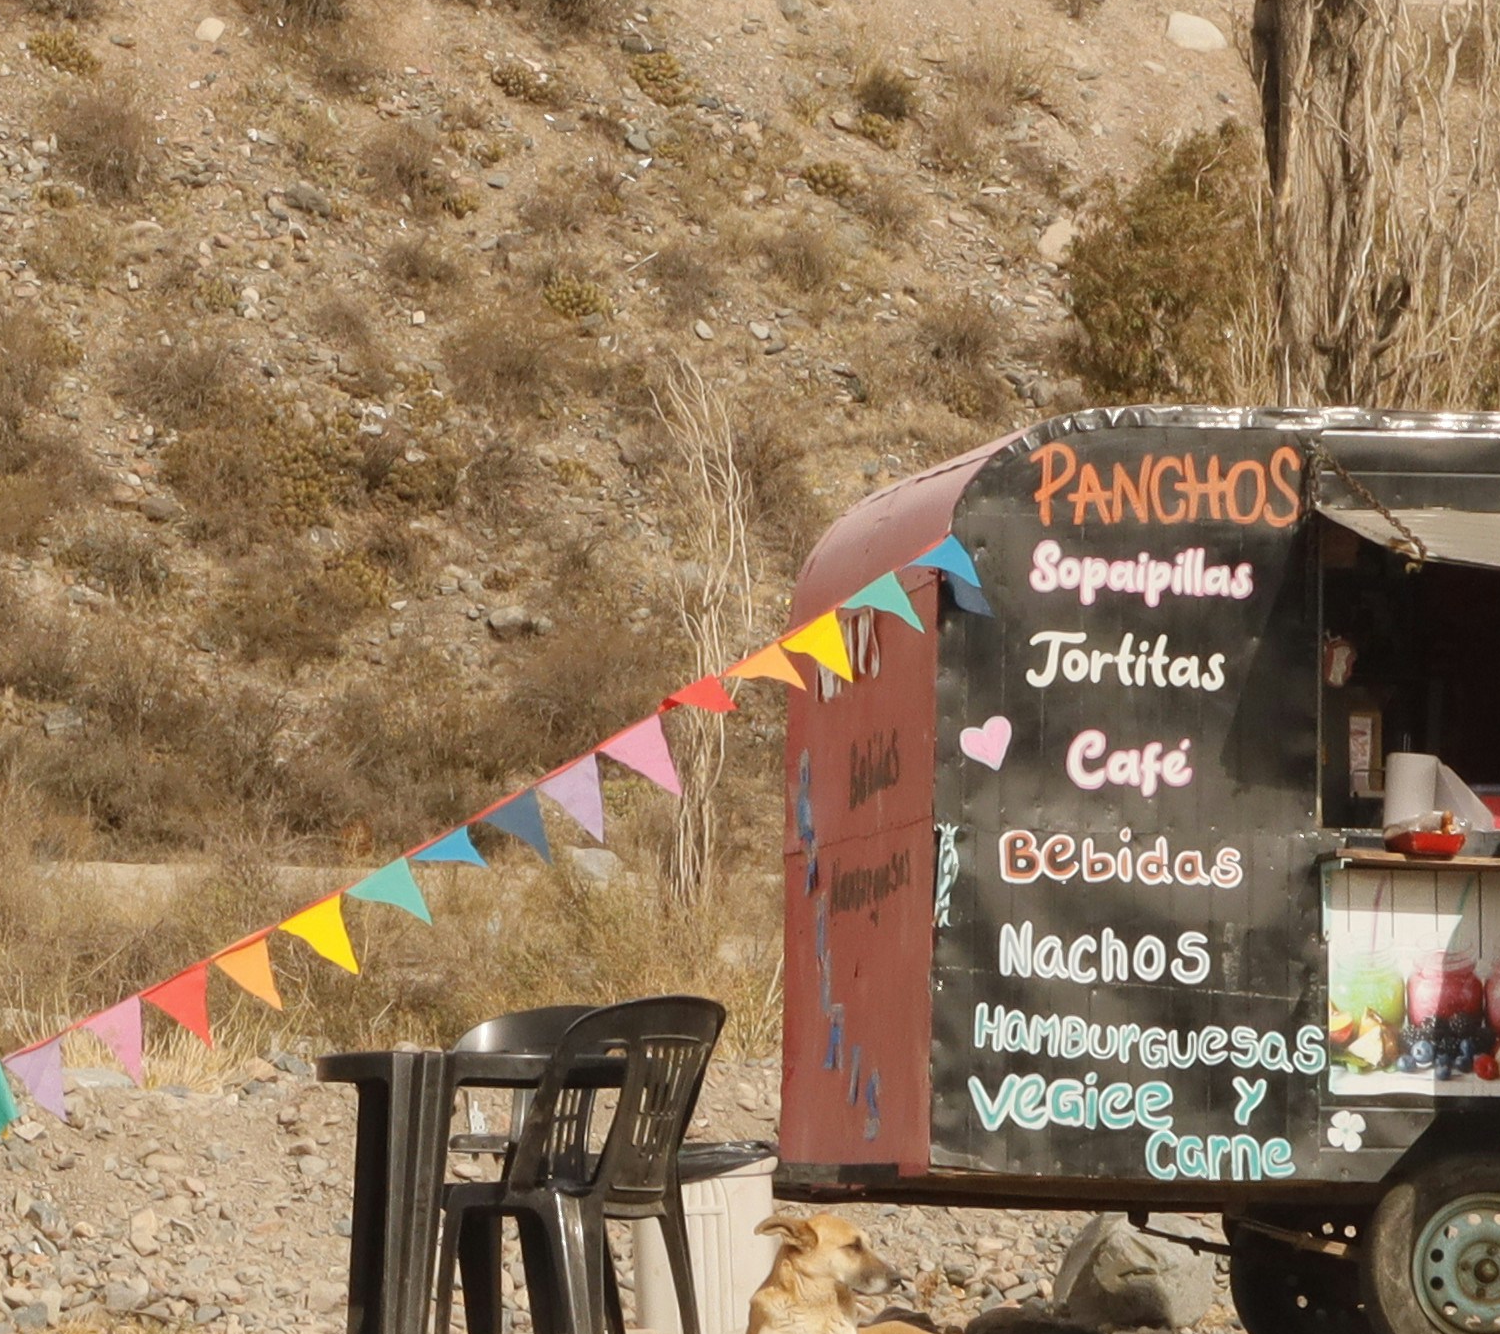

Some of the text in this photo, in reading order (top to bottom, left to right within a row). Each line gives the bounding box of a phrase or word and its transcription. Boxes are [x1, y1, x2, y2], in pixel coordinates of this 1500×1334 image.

[1029, 442, 1301, 528] PANCHOS
[1028, 539, 1255, 608] Sopaipillas
[1025, 630, 1226, 692] Tortitas
[1066, 729, 1194, 798] Café
